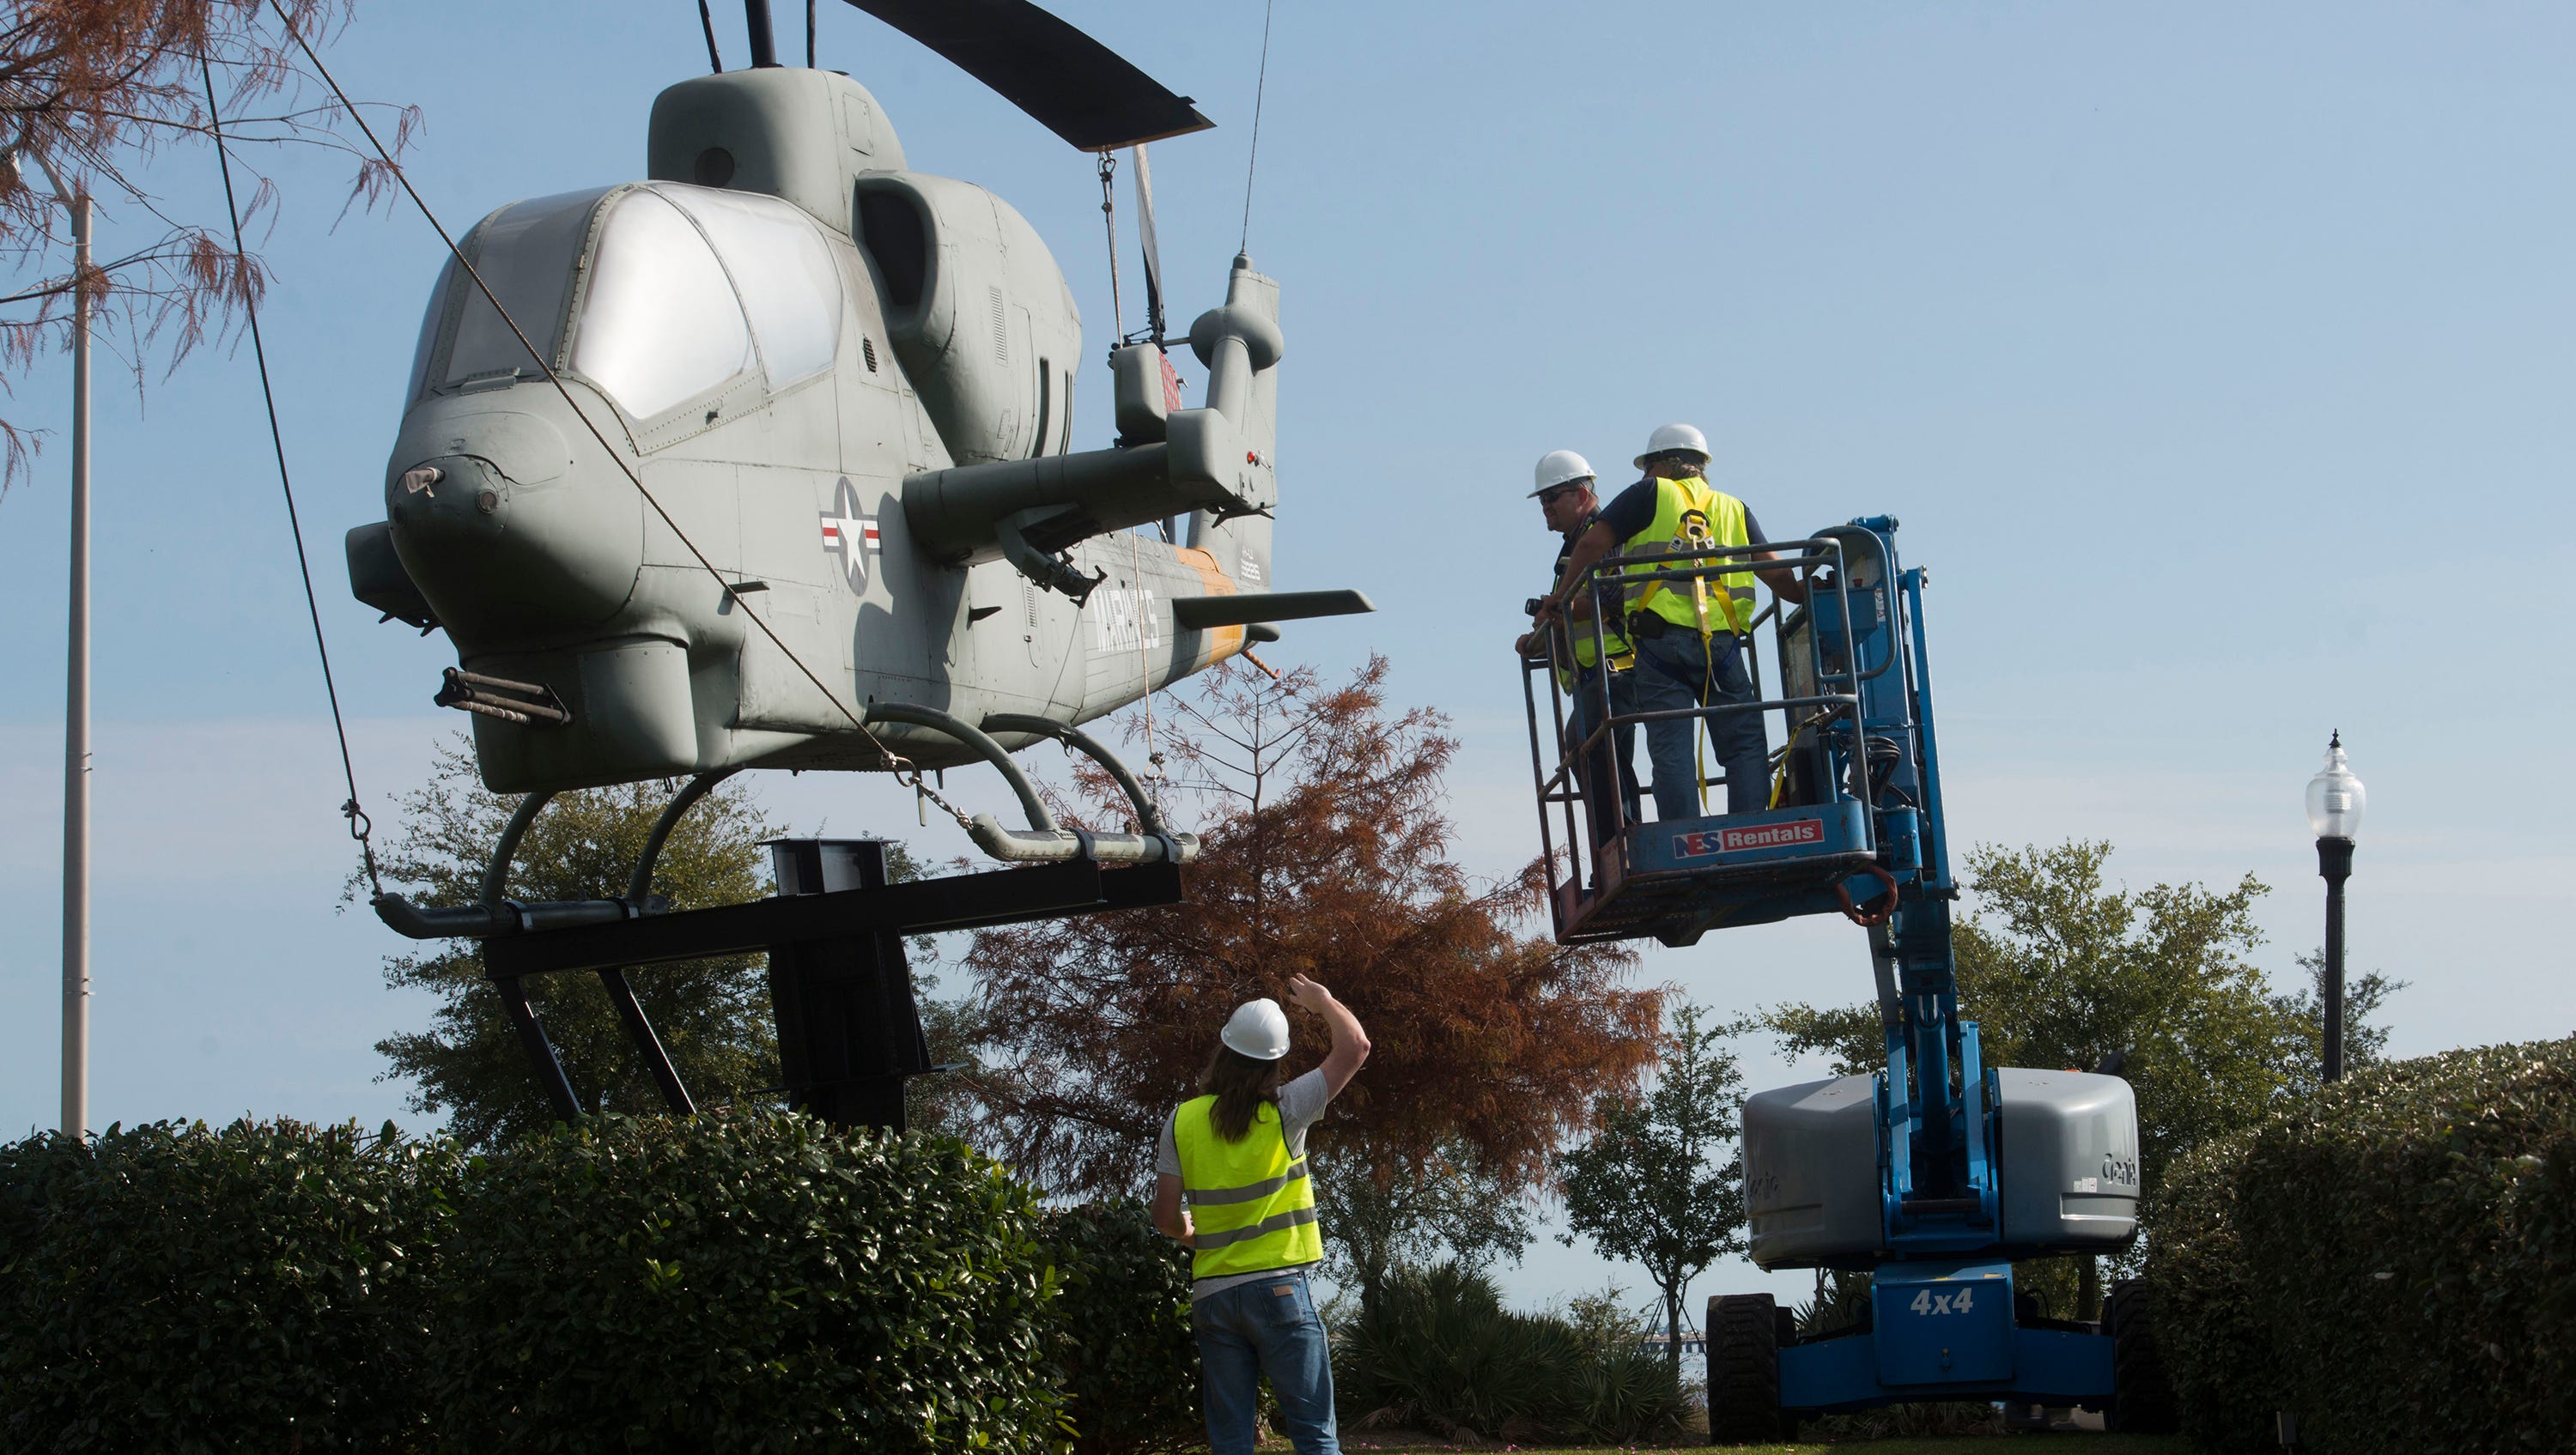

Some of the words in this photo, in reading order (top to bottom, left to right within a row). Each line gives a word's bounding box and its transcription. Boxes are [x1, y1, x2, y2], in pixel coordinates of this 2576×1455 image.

[1091, 588, 1160, 652] MARINES
[1674, 832, 1721, 858] NES
[1727, 825, 1815, 847] Rentals
[1911, 1288, 1973, 1316] 4x4
